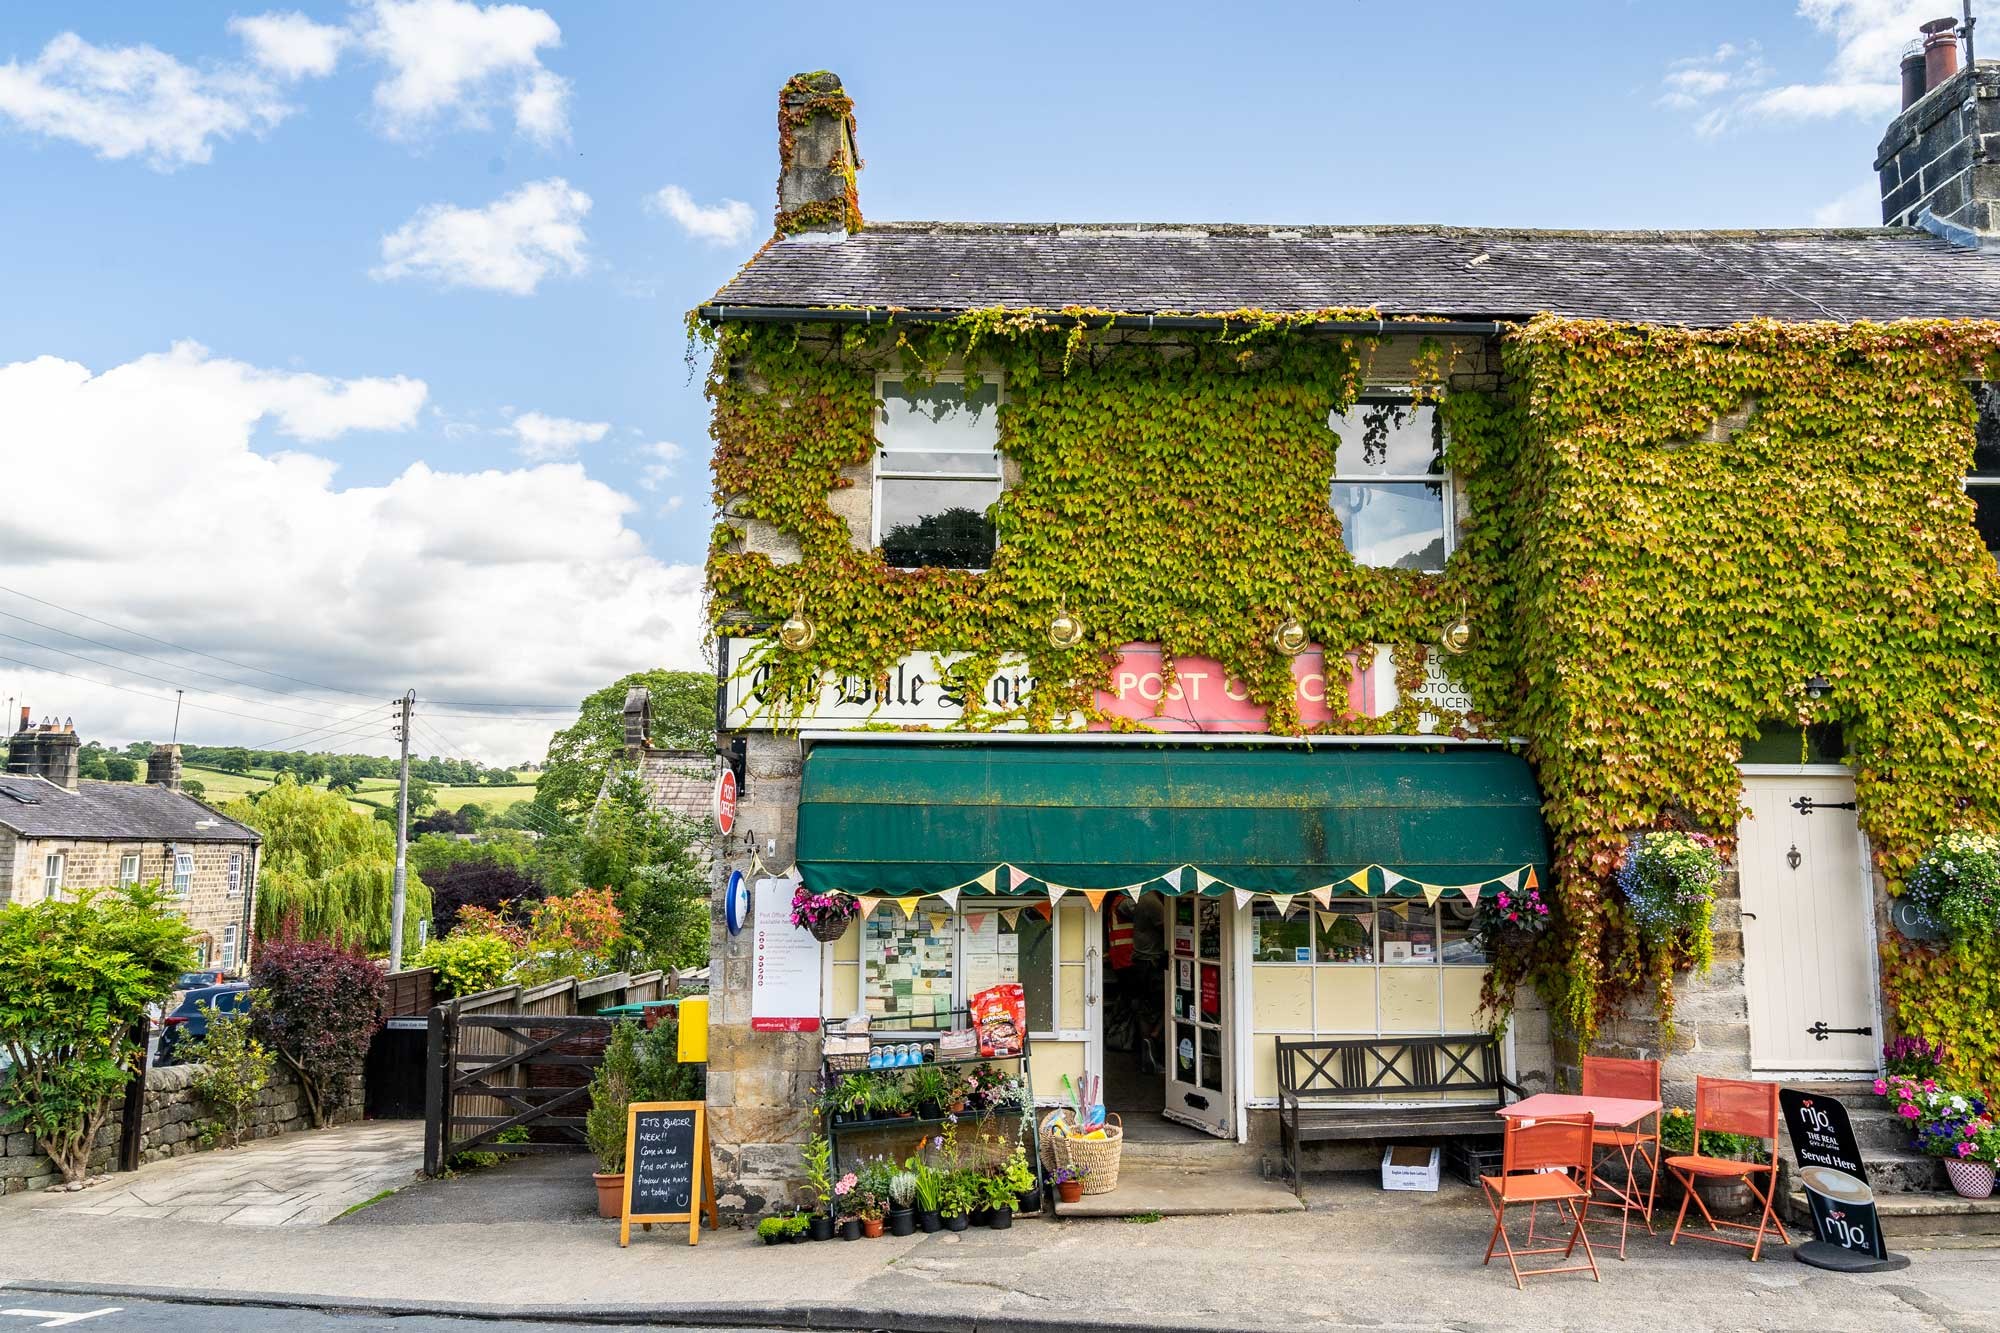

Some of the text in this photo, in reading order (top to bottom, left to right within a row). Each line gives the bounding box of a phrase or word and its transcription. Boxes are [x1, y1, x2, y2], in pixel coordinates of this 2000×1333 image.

[723, 783, 734, 801] POST
[720, 800, 736, 818] OFFICE
[663, 1117, 691, 1129] BURGER
[1807, 1131, 1840, 1146] THE REAL
[641, 1146, 677, 1156] Come in and
[640, 1160, 653, 1172] find
[671, 1161, 688, 1169] what
[1801, 1149, 1857, 1171] Served Here
